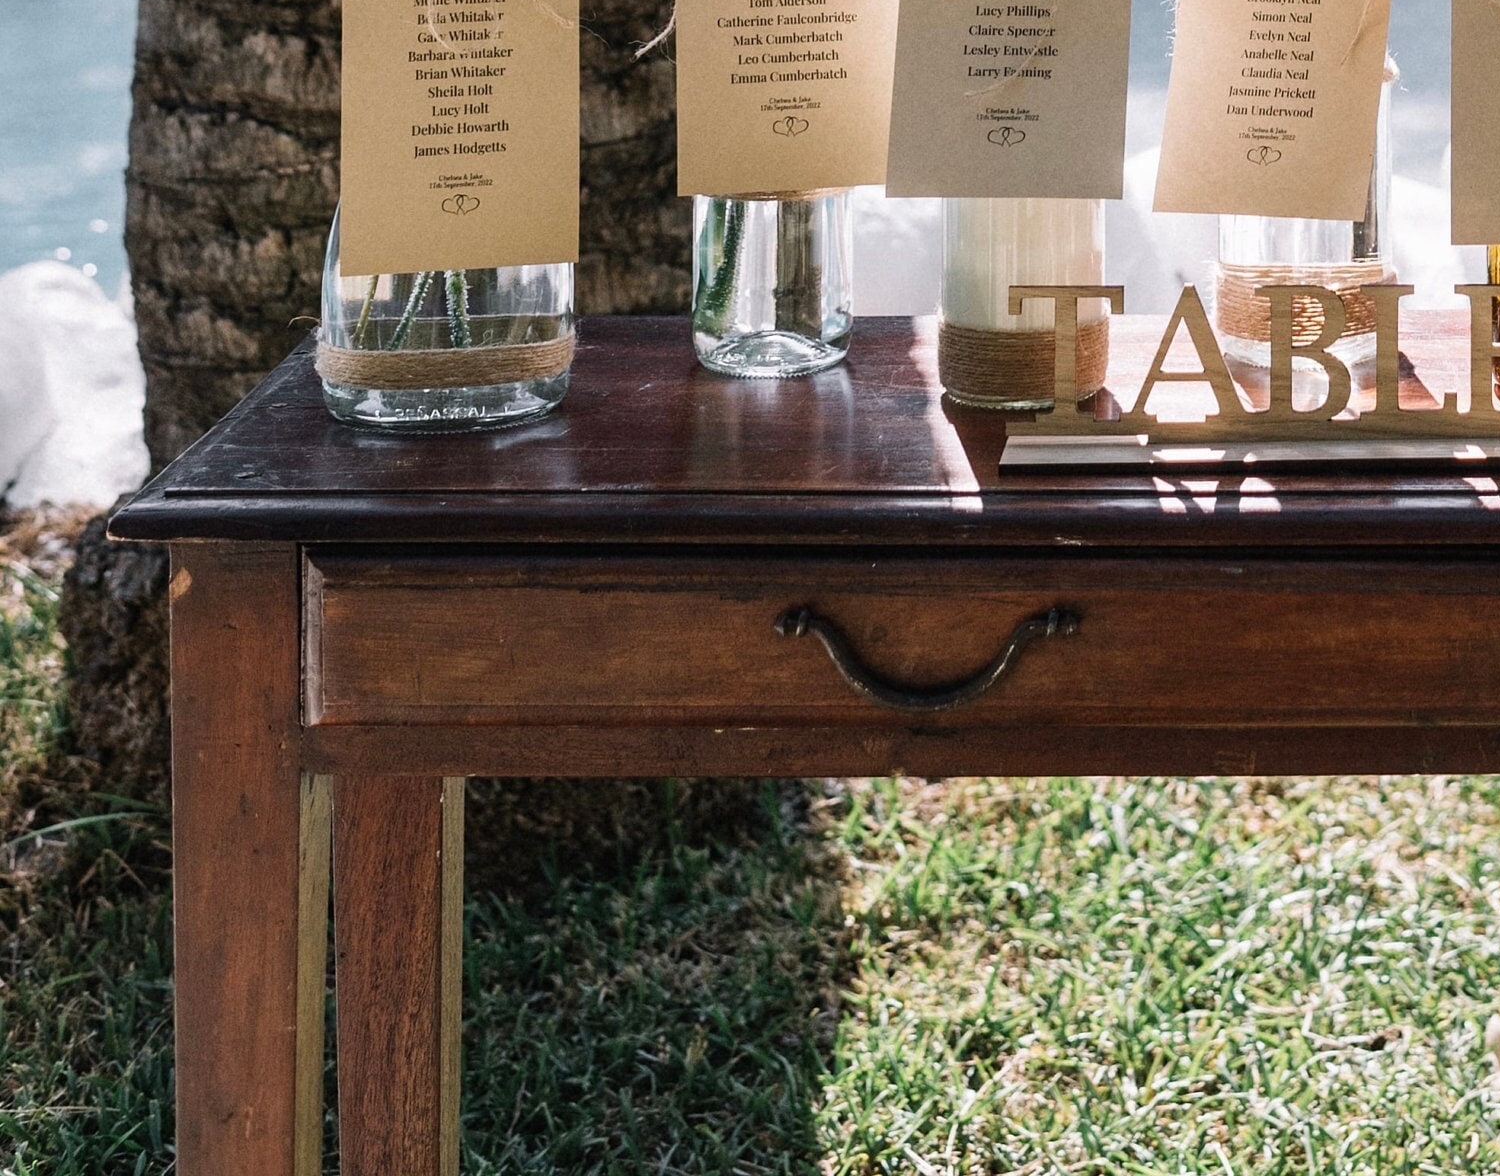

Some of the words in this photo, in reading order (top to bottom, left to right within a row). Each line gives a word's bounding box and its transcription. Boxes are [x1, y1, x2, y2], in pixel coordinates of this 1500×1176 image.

[976, 6, 1004, 18] Lucy
[1007, 6, 1050, 18] Phillips
[1252, 11, 1285, 23] Simon
[1289, 13, 1312, 24] Neal
[717, 16, 773, 28] Catherine
[777, 12, 858, 25] Faulconbridge
[969, 25, 1004, 36] Claire
[1249, 30, 1284, 43] Evelyn
[1287, 31, 1310, 42] Neal
[733, 34, 763, 46] Mark
[766, 31, 842, 44] Cumberbatch
[408, 50, 455, 62] Barbara
[963, 44, 1000, 57] Lesley
[1241, 49, 1287, 60] Anabelle
[1290, 50, 1314, 61] Neal
[738, 54, 758, 65] Leo
[762, 50, 838, 63] Cumberbatch
[415, 69, 448, 80] Brian
[450, 65, 506, 78] Whitaker
[731, 73, 766, 84] Emma
[770, 68, 847, 82] Cumberbatch
[968, 66, 1001, 79] Larry
[1242, 67, 1282, 79] Claudia
[1285, 69, 1309, 80] Neal
[428, 85, 464, 98] Sheila
[468, 84, 492, 96] Holt
[1228, 86, 1271, 98] Jasmine
[1274, 87, 1315, 99] Prickett
[432, 105, 461, 117] Lucy
[464, 103, 489, 114] Holt
[1227, 104, 1247, 115] Dan
[1251, 105, 1313, 118] Underwood
[411, 123, 453, 136] Debbie
[457, 120, 509, 133] Howarth
[414, 144, 449, 159] James
[453, 141, 506, 155] Hodgetts
